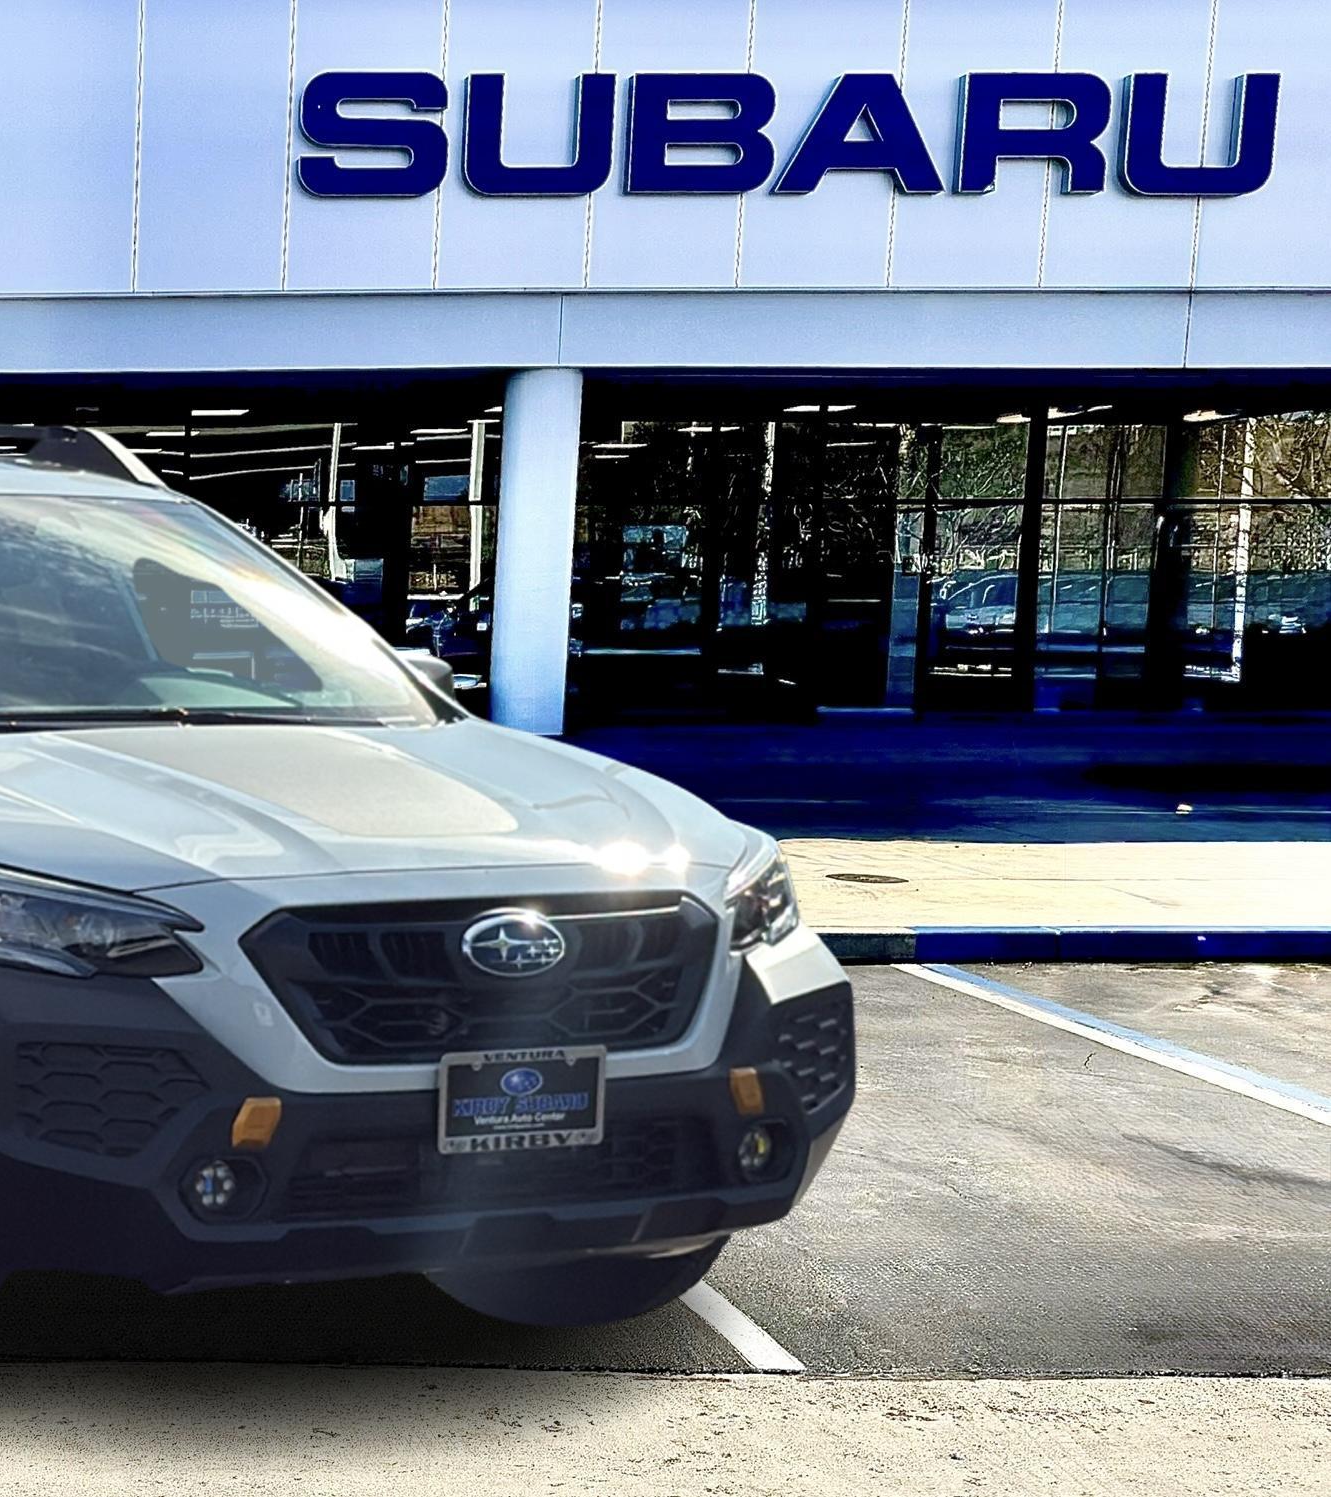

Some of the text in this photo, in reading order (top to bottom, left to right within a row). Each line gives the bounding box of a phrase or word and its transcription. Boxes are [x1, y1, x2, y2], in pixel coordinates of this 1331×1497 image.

[295, 70, 1282, 197] SUBARU
[484, 1050, 565, 1061] VENTURA
[454, 1093, 589, 1115] KIRBY SUBARU
[474, 1111, 566, 1125] Ventura Auto Center
[470, 1133, 572, 1150] KIRBY
